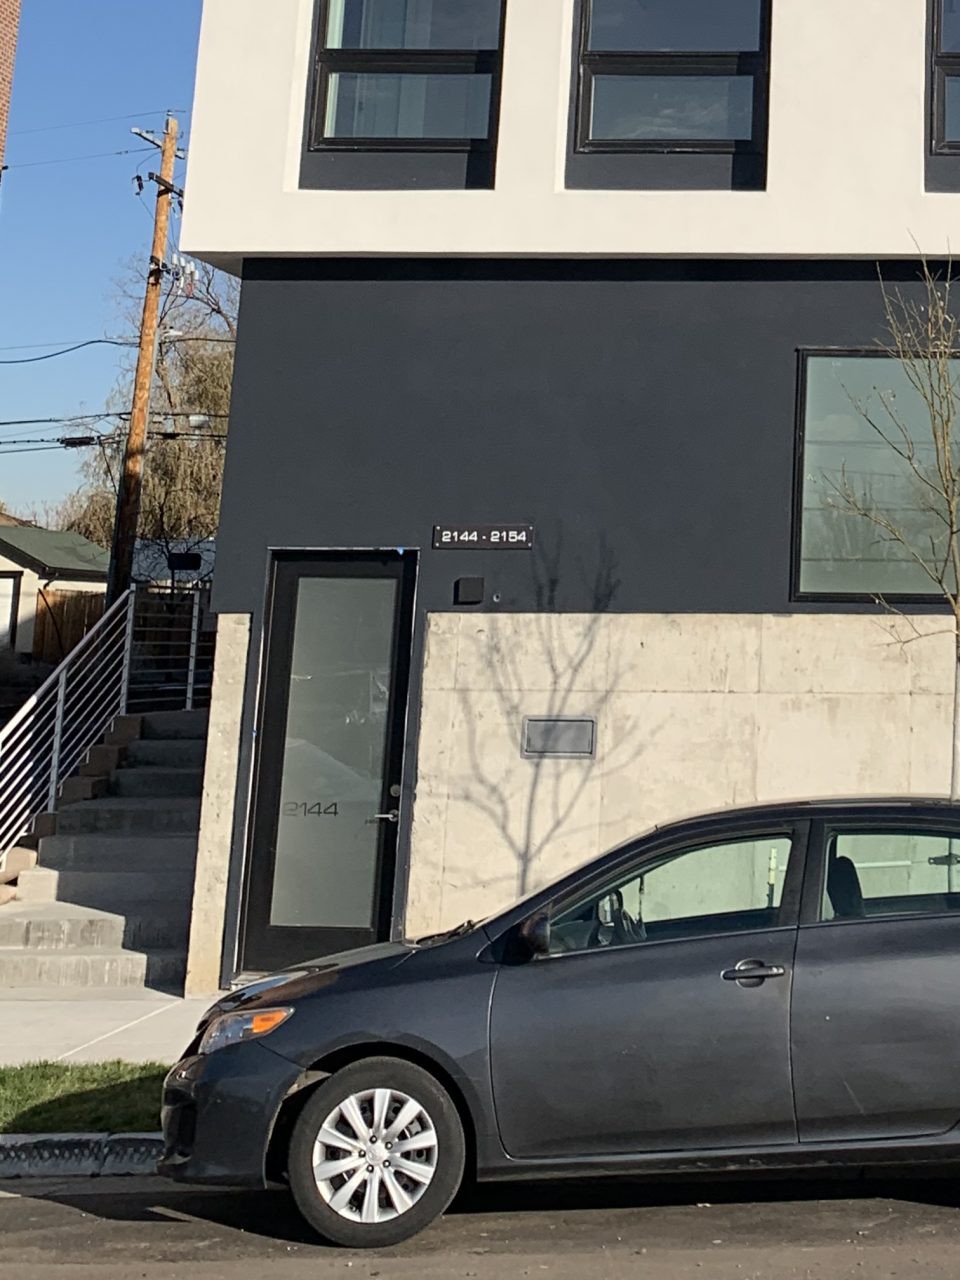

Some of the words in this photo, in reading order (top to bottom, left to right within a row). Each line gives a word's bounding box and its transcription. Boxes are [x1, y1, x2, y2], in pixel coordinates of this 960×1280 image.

[441, 531, 478, 542] 2144
[490, 531, 527, 542] 2154
[283, 801, 339, 817] 2144
